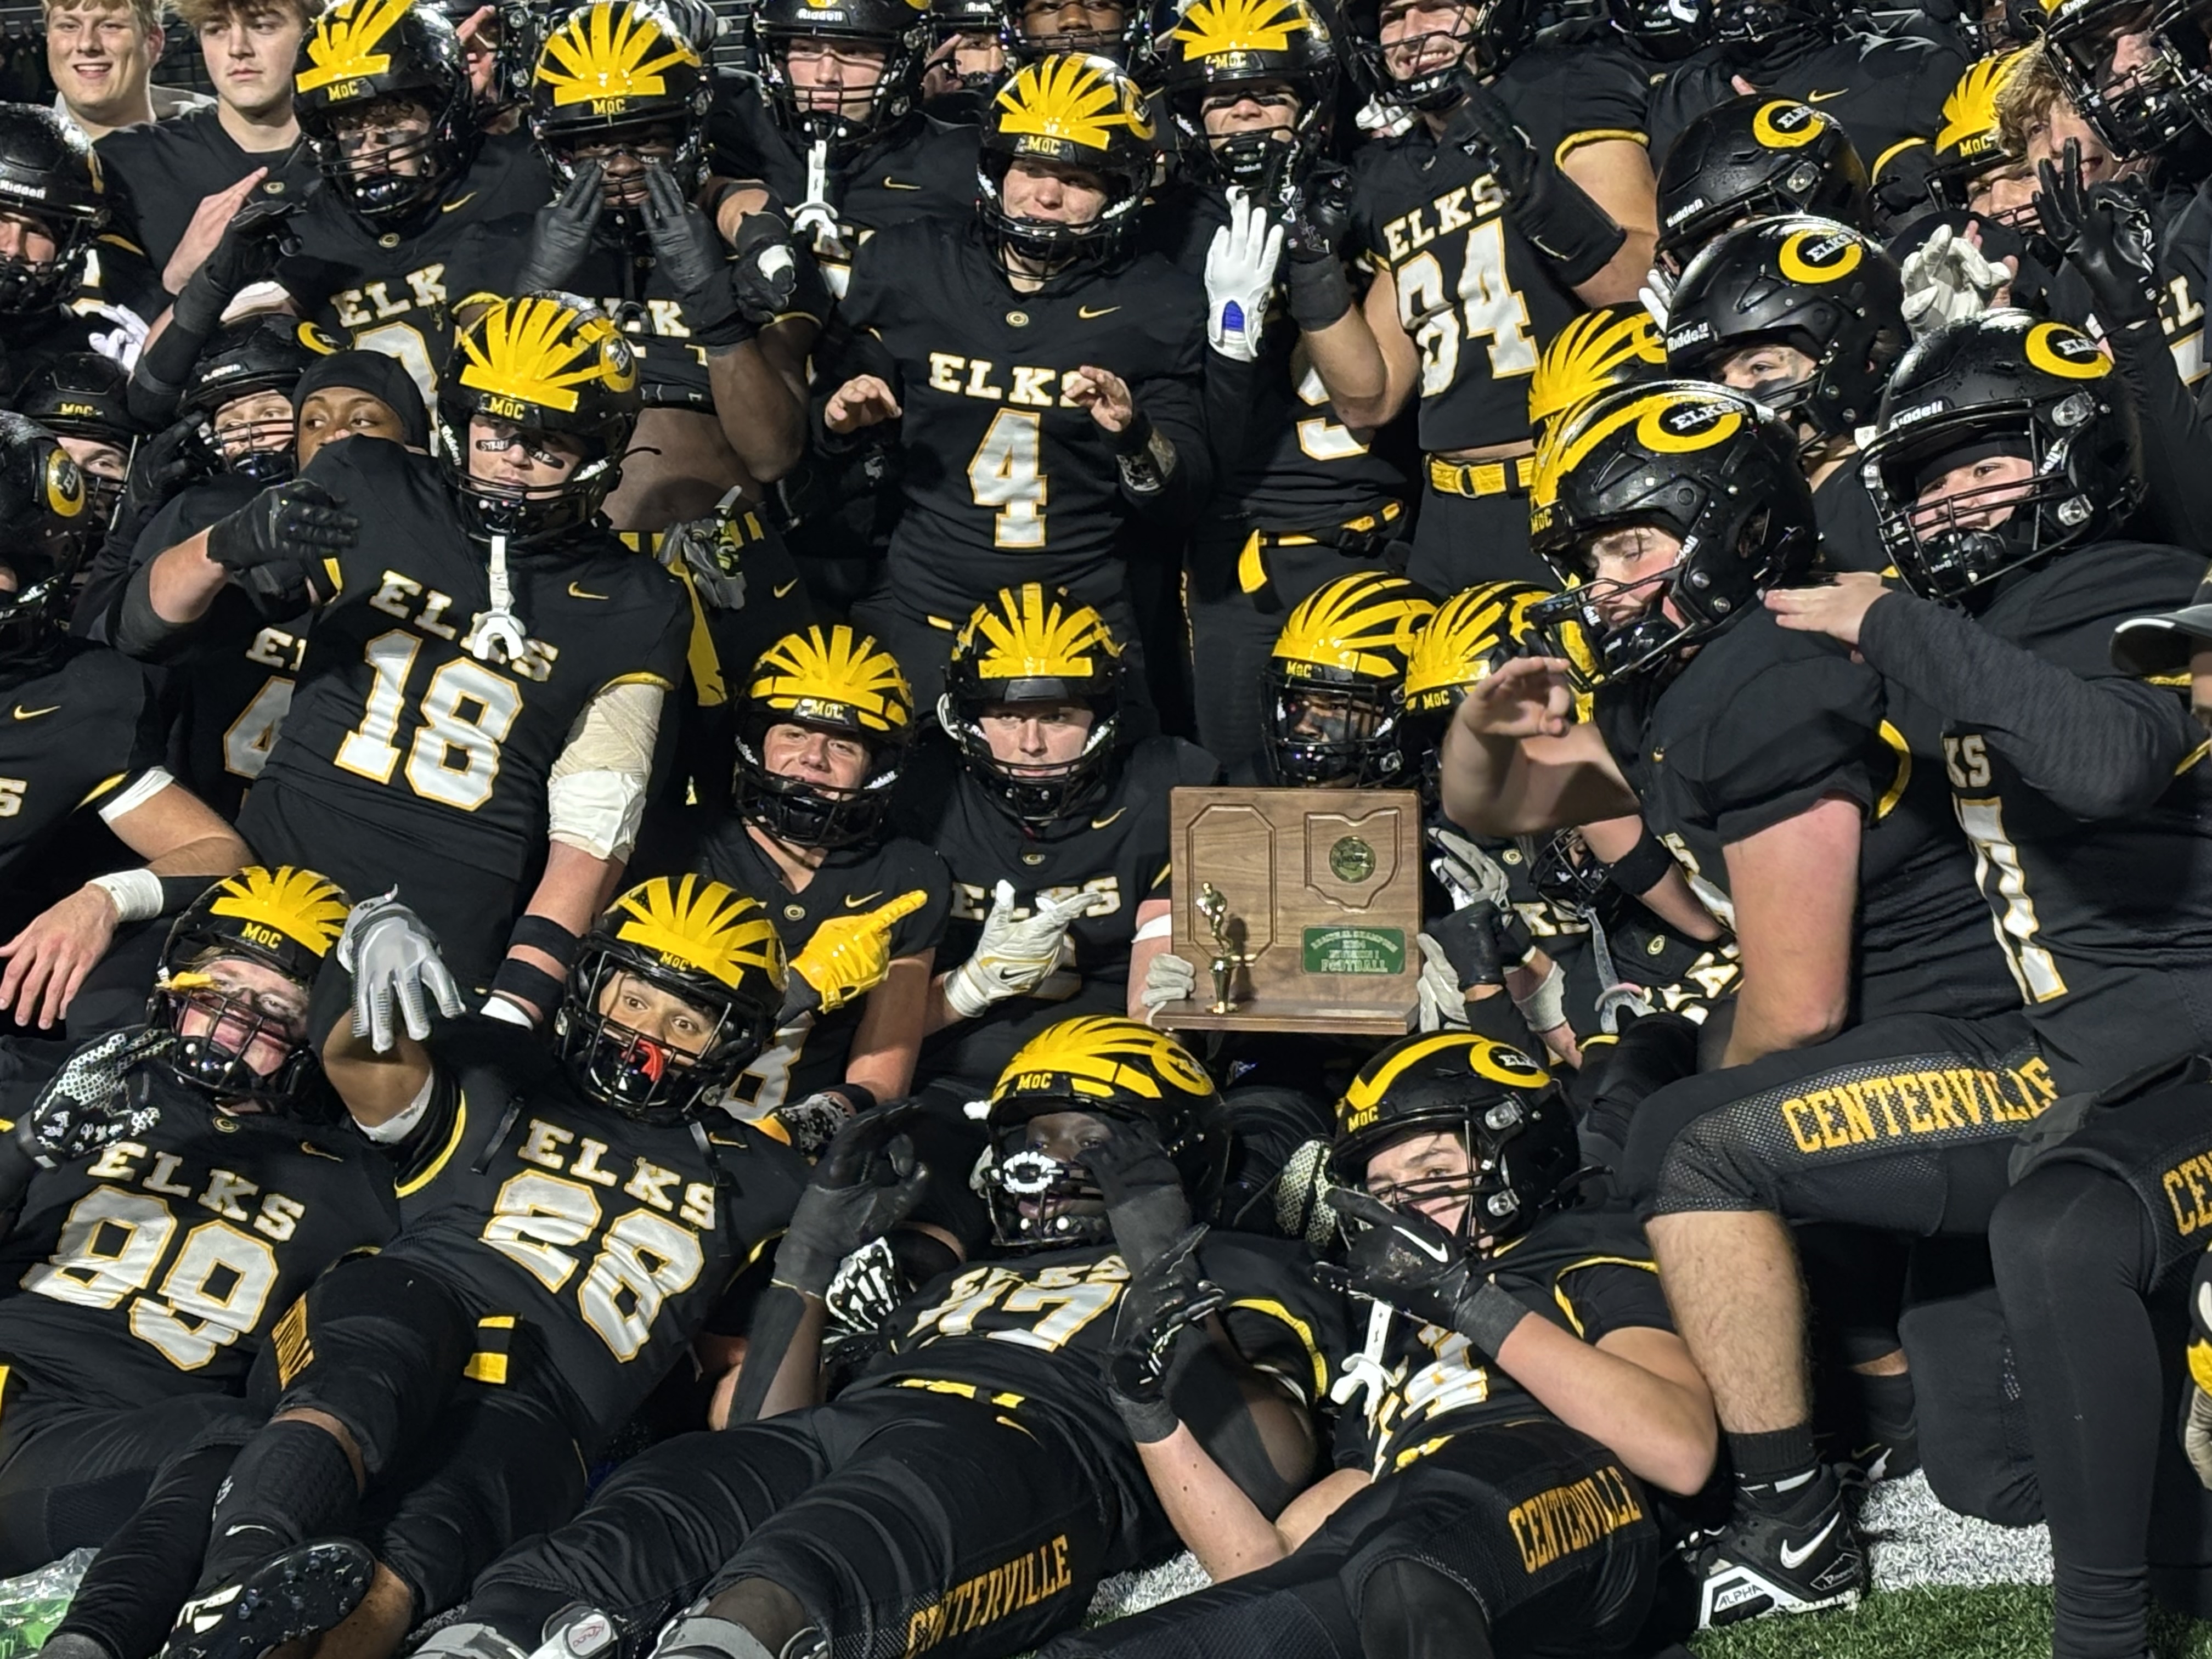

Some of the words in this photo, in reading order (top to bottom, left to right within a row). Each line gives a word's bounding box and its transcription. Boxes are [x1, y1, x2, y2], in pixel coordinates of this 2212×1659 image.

[798, 7, 843, 21] Riddell
[328, 81, 359, 101] MOC
[592, 99, 625, 115] MOC
[1028, 136, 1061, 155] MOC
[1959, 135, 1991, 157] MOC
[1384, 173, 1508, 262] ELKS
[61, 403, 93, 416] MOC
[489, 397, 525, 420] MOC
[967, 407, 1047, 548] 4
[1286, 661, 1312, 678] MOC
[811, 700, 844, 719] MOC
[1423, 690, 1450, 710] MOC
[334, 628, 523, 812] 18
[242, 922, 282, 949] MOC
[660, 952, 688, 972] MOC
[1321, 959, 1388, 972] FOOTBALL
[1017, 1073, 1052, 1091] MOC
[1348, 1107, 1378, 1132] MOC
[518, 1119, 715, 1229] ELKS
[86, 1141, 305, 1242] ELKS
